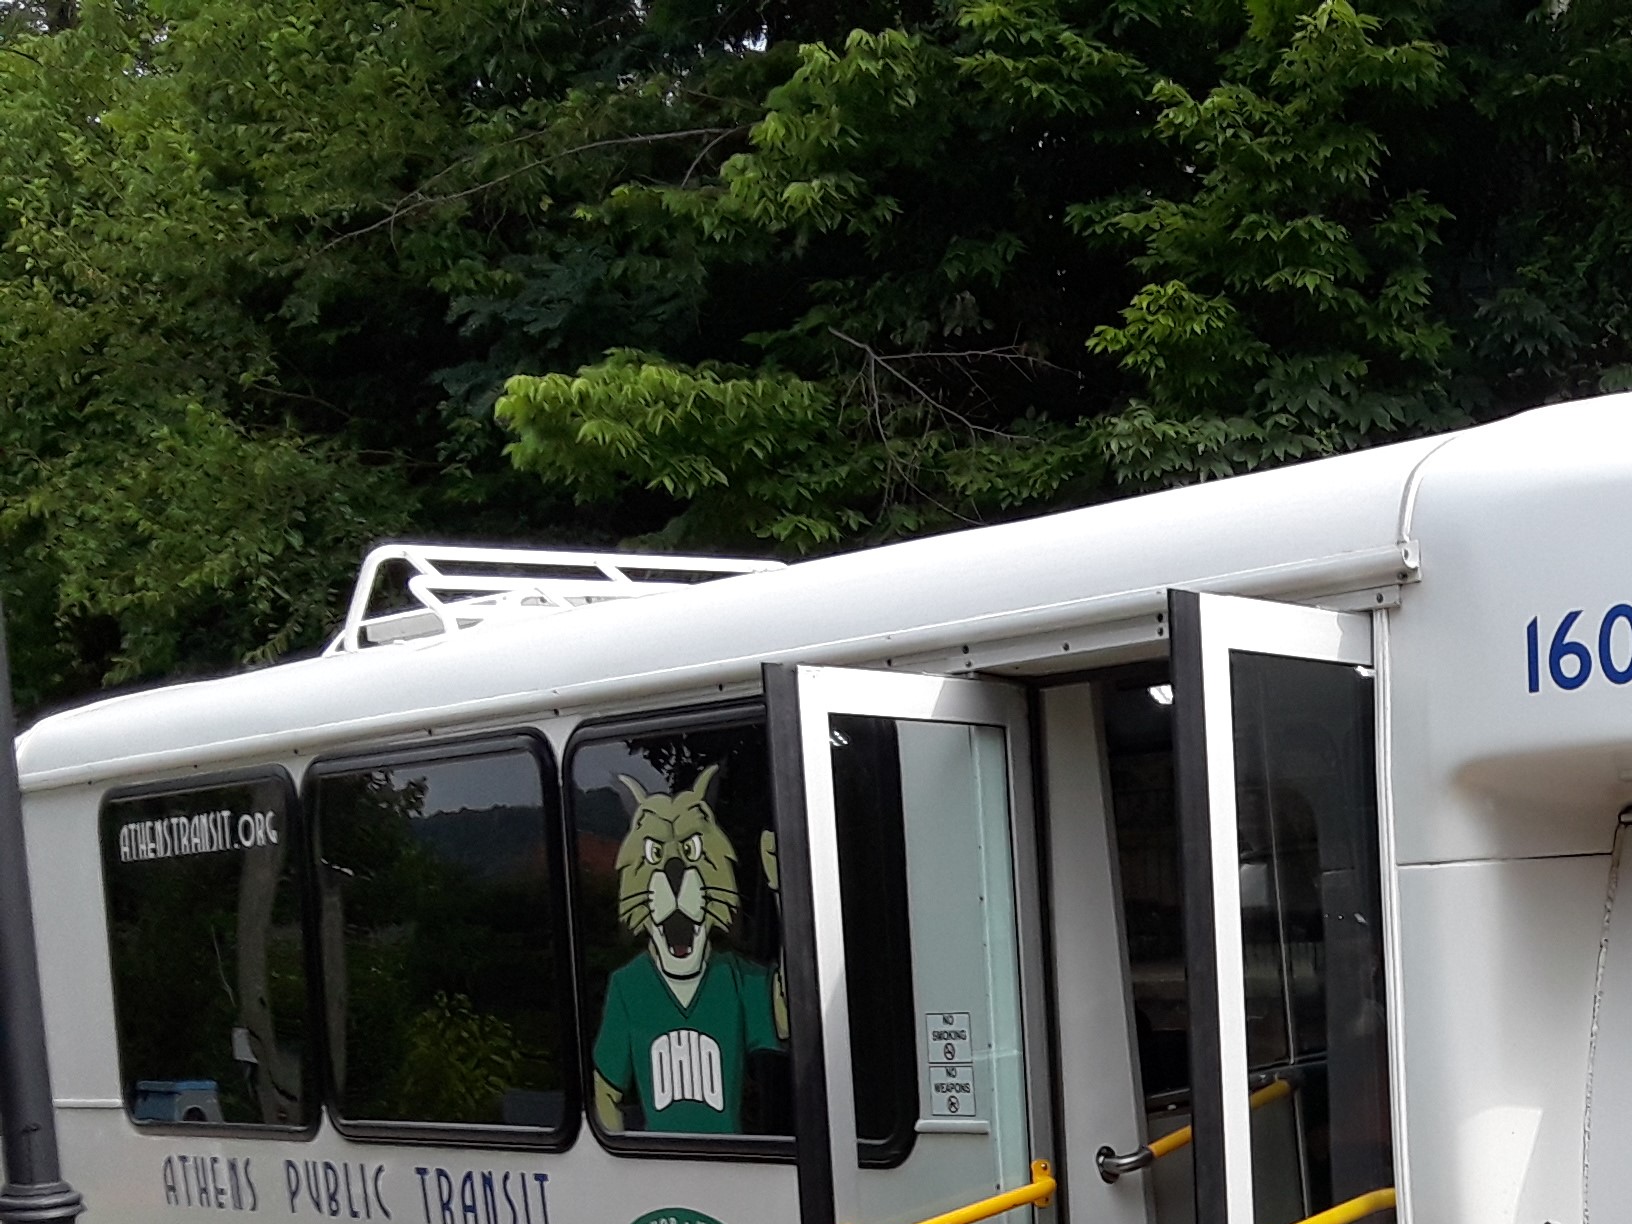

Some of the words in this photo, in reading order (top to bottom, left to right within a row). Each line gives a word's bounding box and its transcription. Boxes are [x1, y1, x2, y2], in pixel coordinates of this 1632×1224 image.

[119, 809, 279, 863] ATHENSTRANSIT.ORG
[942, 1014, 955, 1026] NO
[649, 1028, 725, 1112] OHIO
[162, 1154, 259, 1212] ATHENS
[284, 1158, 392, 1221] PUBLIC
